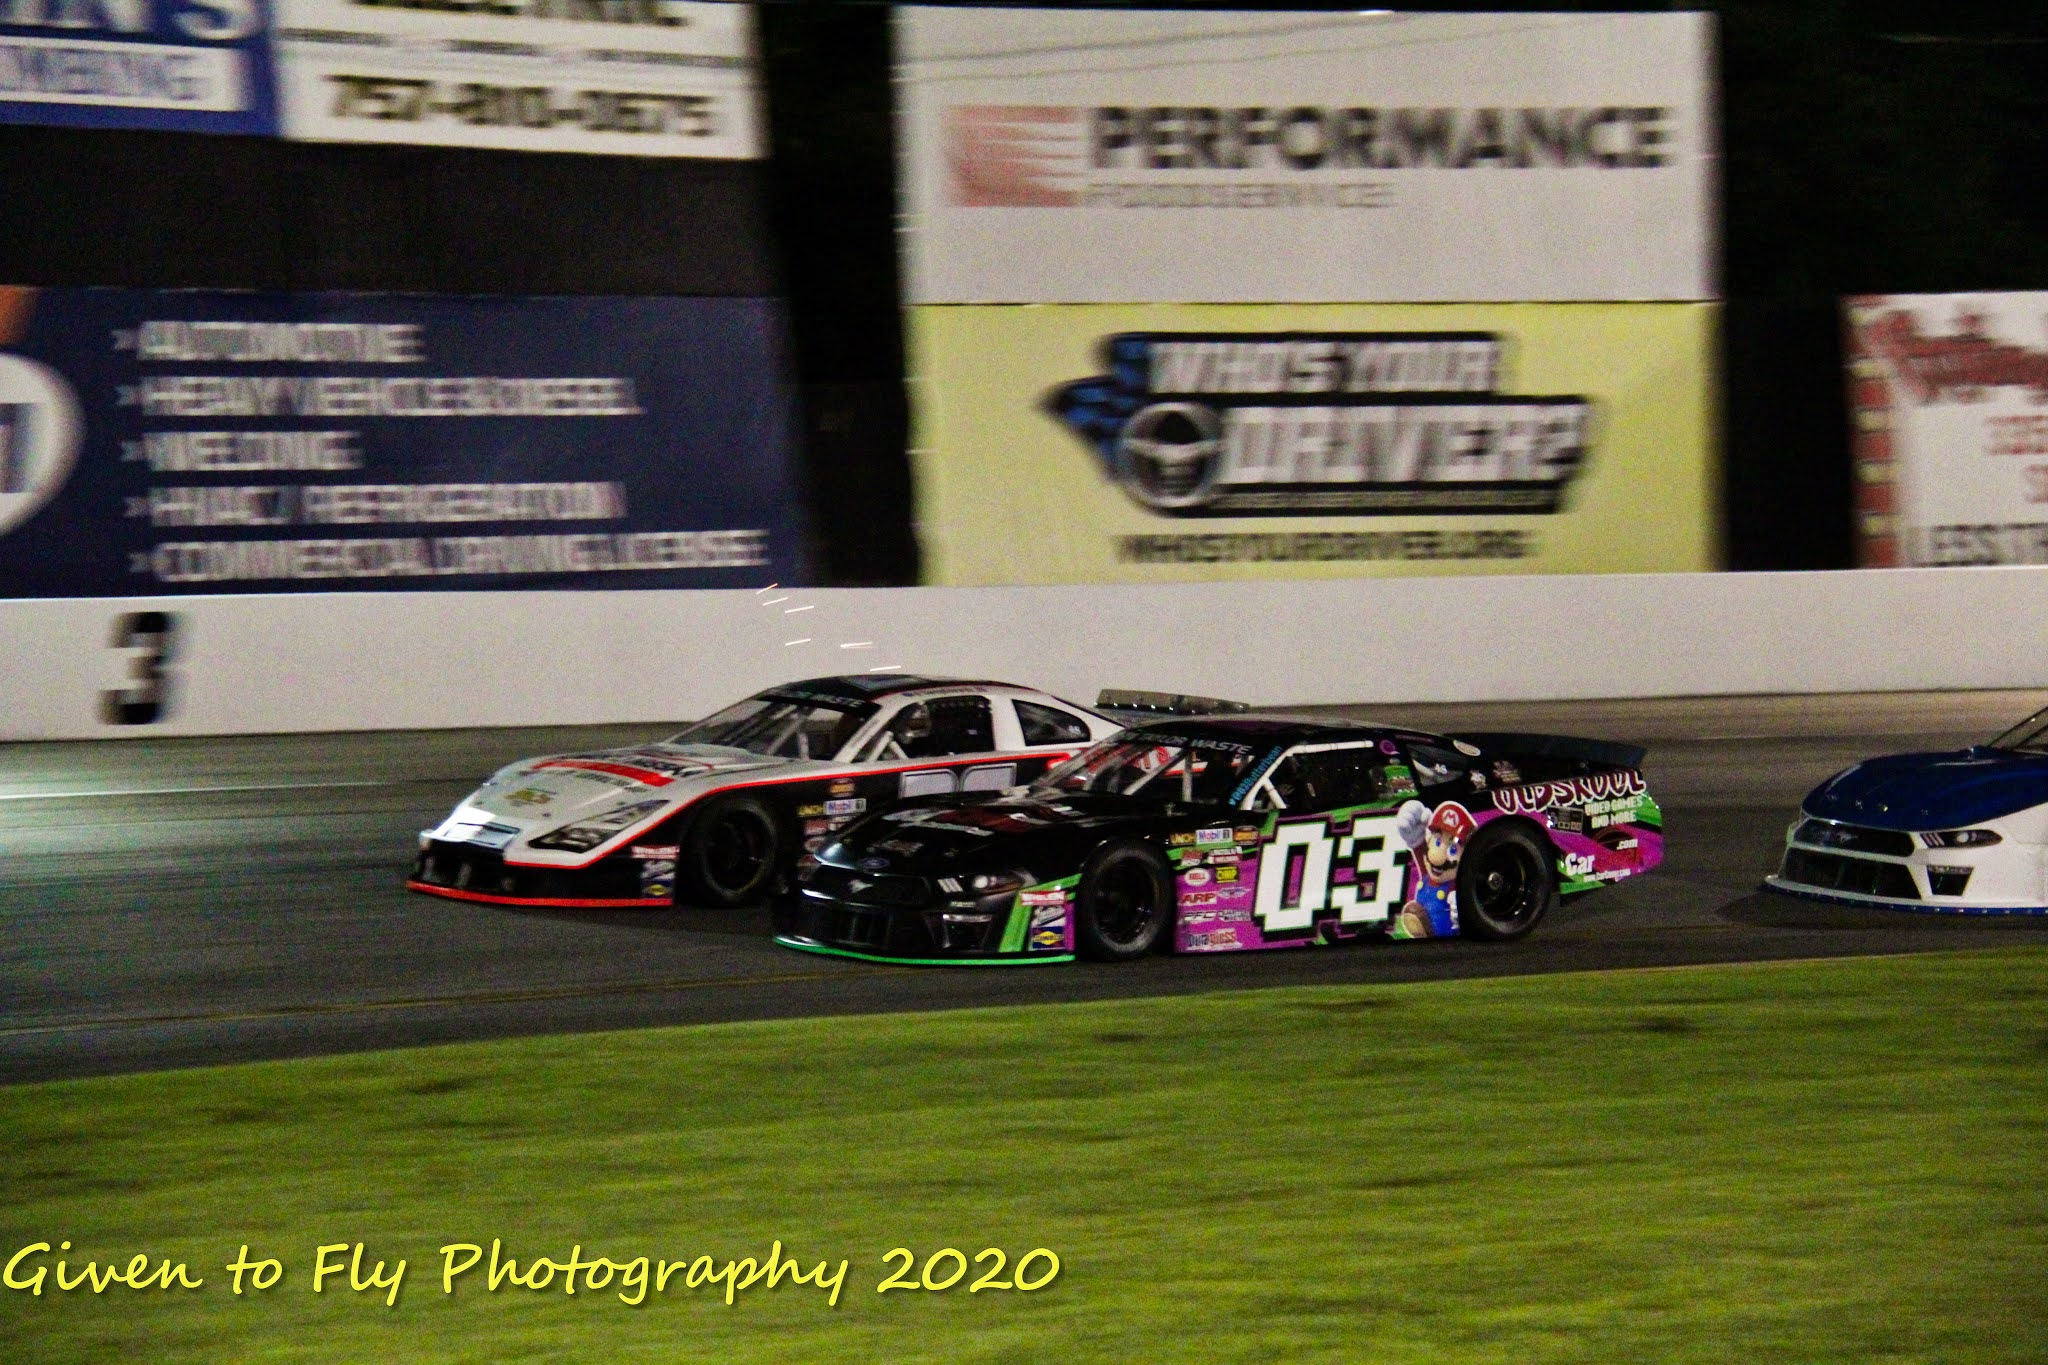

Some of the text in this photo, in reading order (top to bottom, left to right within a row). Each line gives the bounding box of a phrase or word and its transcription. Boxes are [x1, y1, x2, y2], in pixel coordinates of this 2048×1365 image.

[1091, 106, 1674, 168] PERFORMANCE
[98, 611, 183, 726] 3
[1254, 816, 1406, 932] 03
[1565, 853, 1595, 876] Car
